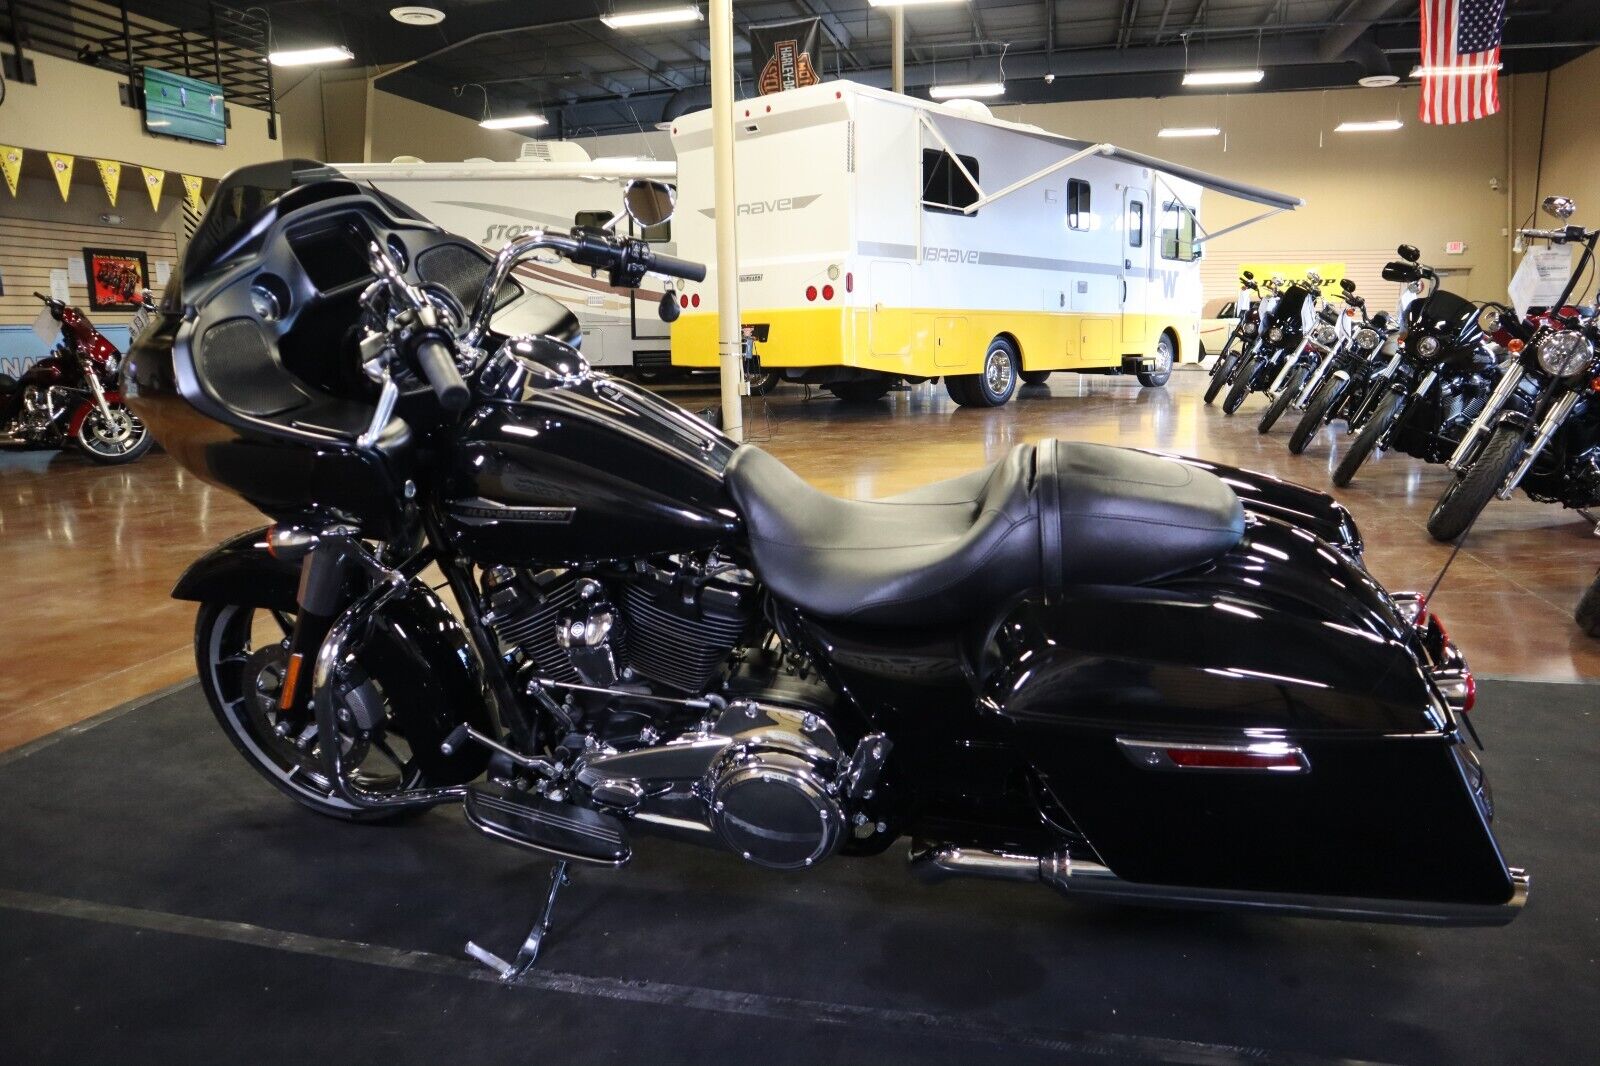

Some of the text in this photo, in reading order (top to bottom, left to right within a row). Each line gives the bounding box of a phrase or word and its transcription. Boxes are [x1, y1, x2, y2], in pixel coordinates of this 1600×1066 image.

[763, 65, 779, 92] CYCL
[780, 46, 796, 91] HARLEY-DA
[797, 62, 814, 85] MOT
[737, 198, 792, 216] Rave
[1261, 279, 1337, 287] DNP
